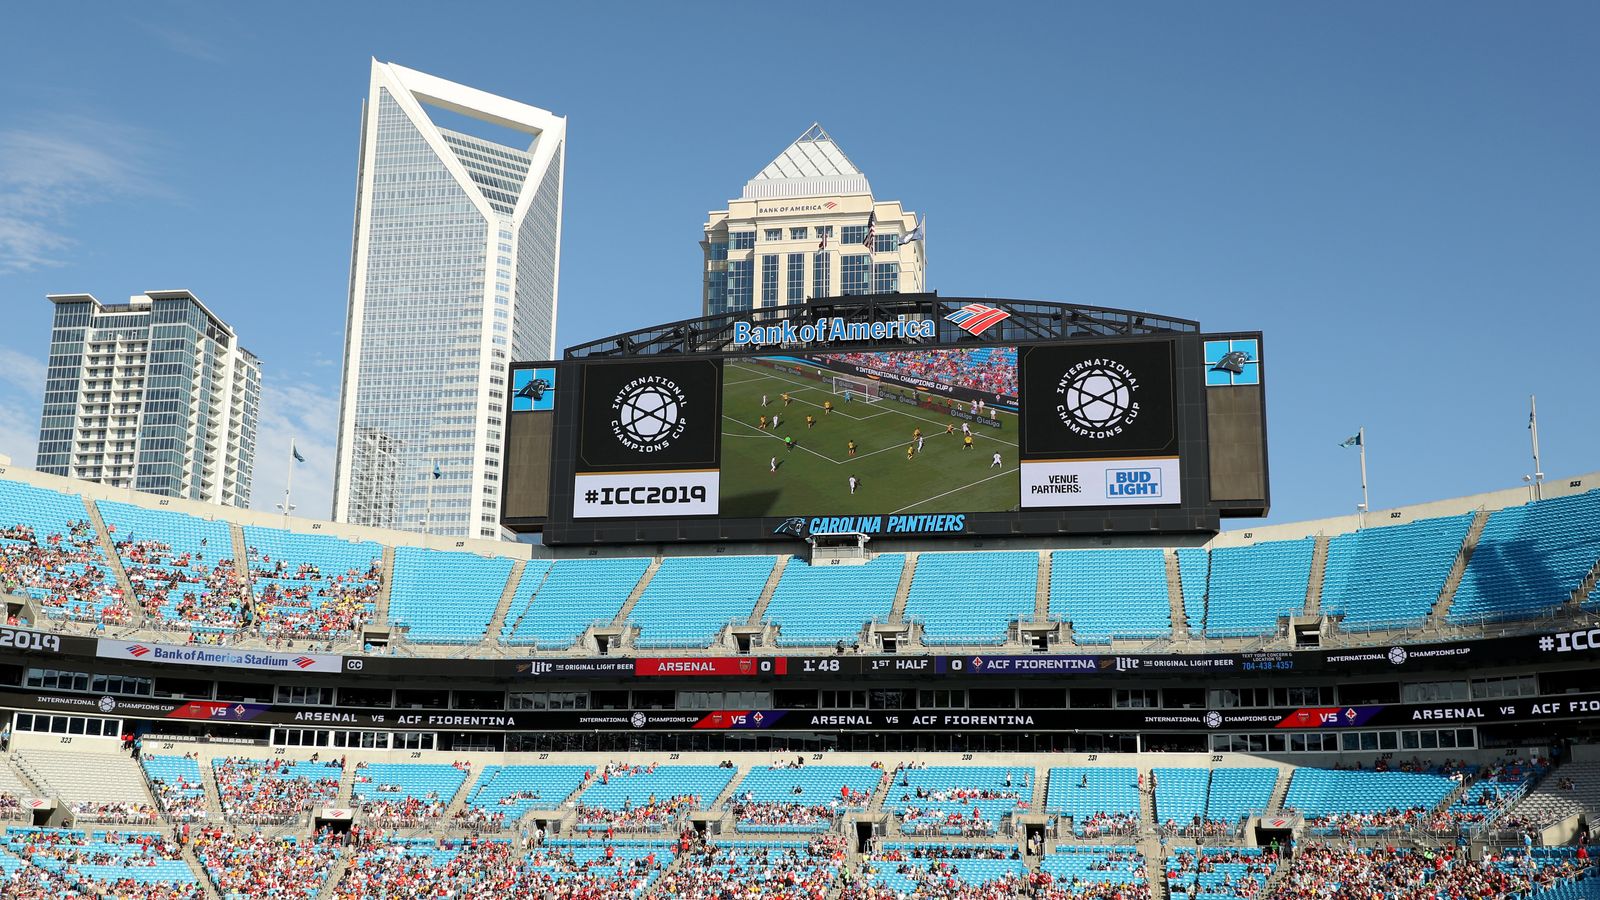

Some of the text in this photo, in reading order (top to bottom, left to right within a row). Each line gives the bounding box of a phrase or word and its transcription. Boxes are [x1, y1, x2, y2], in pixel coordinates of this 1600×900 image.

[734, 315, 936, 344] Bank of America
[860, 367, 949, 392] INTERNATIONAL CHAMPIONS CUP
[1057, 358, 1140, 394] INTERNATIONAL
[612, 376, 687, 410] INTERNATIONAL
[1056, 401, 1140, 439] CHAMPIONS CUP
[610, 417, 687, 452] CHAMPIONS CUP
[1048, 474, 1079, 484] VENUE
[1116, 472, 1151, 483] BUD
[584, 486, 706, 505] #ICC2019
[1031, 484, 1082, 495] PARTNERS:
[1109, 483, 1159, 496] LIGHT
[809, 514, 966, 535] CAROLINA PANTHERS
[0, 630, 60, 652] 2019
[154, 648, 289, 667] Bank of America Stadium
[1327, 648, 1470, 663] INTERNATIONAL CHAMPIONS CUP
[348, 661, 362, 670] CC
[531, 661, 553, 675] Lite
[658, 662, 716, 672] ARSENAL
[760, 661, 771, 672] 0
[803, 660, 840, 672] 1:48
[872, 660, 928, 670] 1ST HALF
[951, 660, 962, 670] 0
[987, 660, 1010, 670] ACF
[1015, 659, 1096, 670] FIORENTINA
[1115, 656, 1140, 672] Lite
[1242, 661, 1294, 670] 704-438-4357
[37, 696, 95, 706] INTERNATIONAL
[117, 702, 159, 710] CHAMPIONS
[210, 707, 227, 717] VS
[1412, 701, 1600, 720] ARSENAL VS ACF FIO
[295, 712, 358, 722] ARSENAL
[398, 715, 422, 724] ACF
[428, 716, 515, 726] FIORENTINA
[730, 715, 747, 725] VS
[811, 716, 872, 725] ARSENAL
[912, 716, 938, 725] ACF
[944, 716, 1034, 725] FIORENTINA
[1319, 713, 1338, 723] VS
